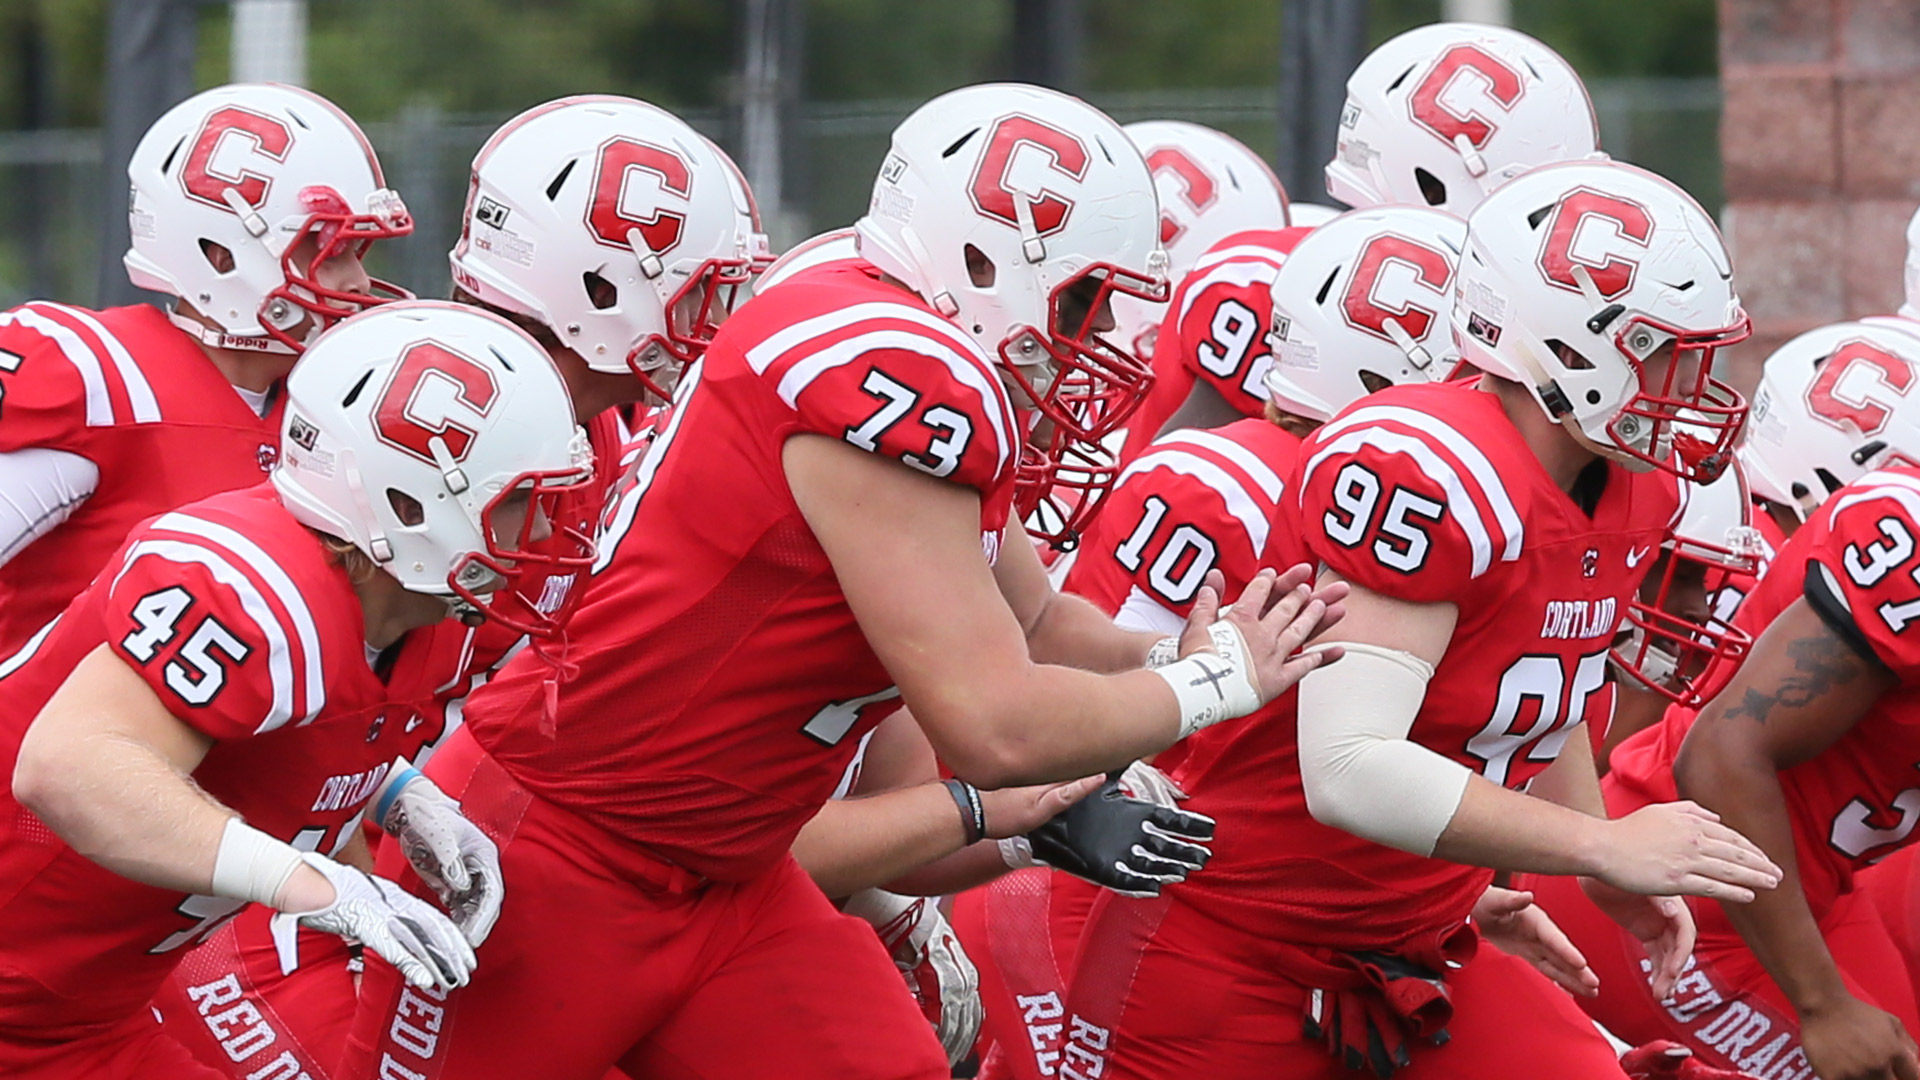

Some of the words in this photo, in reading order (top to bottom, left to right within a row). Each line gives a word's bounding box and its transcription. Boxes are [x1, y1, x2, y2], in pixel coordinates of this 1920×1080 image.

[1405, 42, 1526, 152] C
[178, 104, 297, 213] C
[584, 134, 694, 258] C
[966, 112, 1092, 239] C
[1338, 229, 1457, 346] C
[1534, 185, 1657, 303] C
[221, 334, 269, 350] Riddel
[1803, 336, 1917, 438] C
[369, 337, 501, 470] C
[844, 365, 975, 480] 73
[1115, 494, 1219, 604] 10
[1322, 461, 1445, 574] 95
[121, 584, 250, 706] 45
[1541, 596, 1617, 640] CORTLAND
[187, 972, 277, 1063] RED
